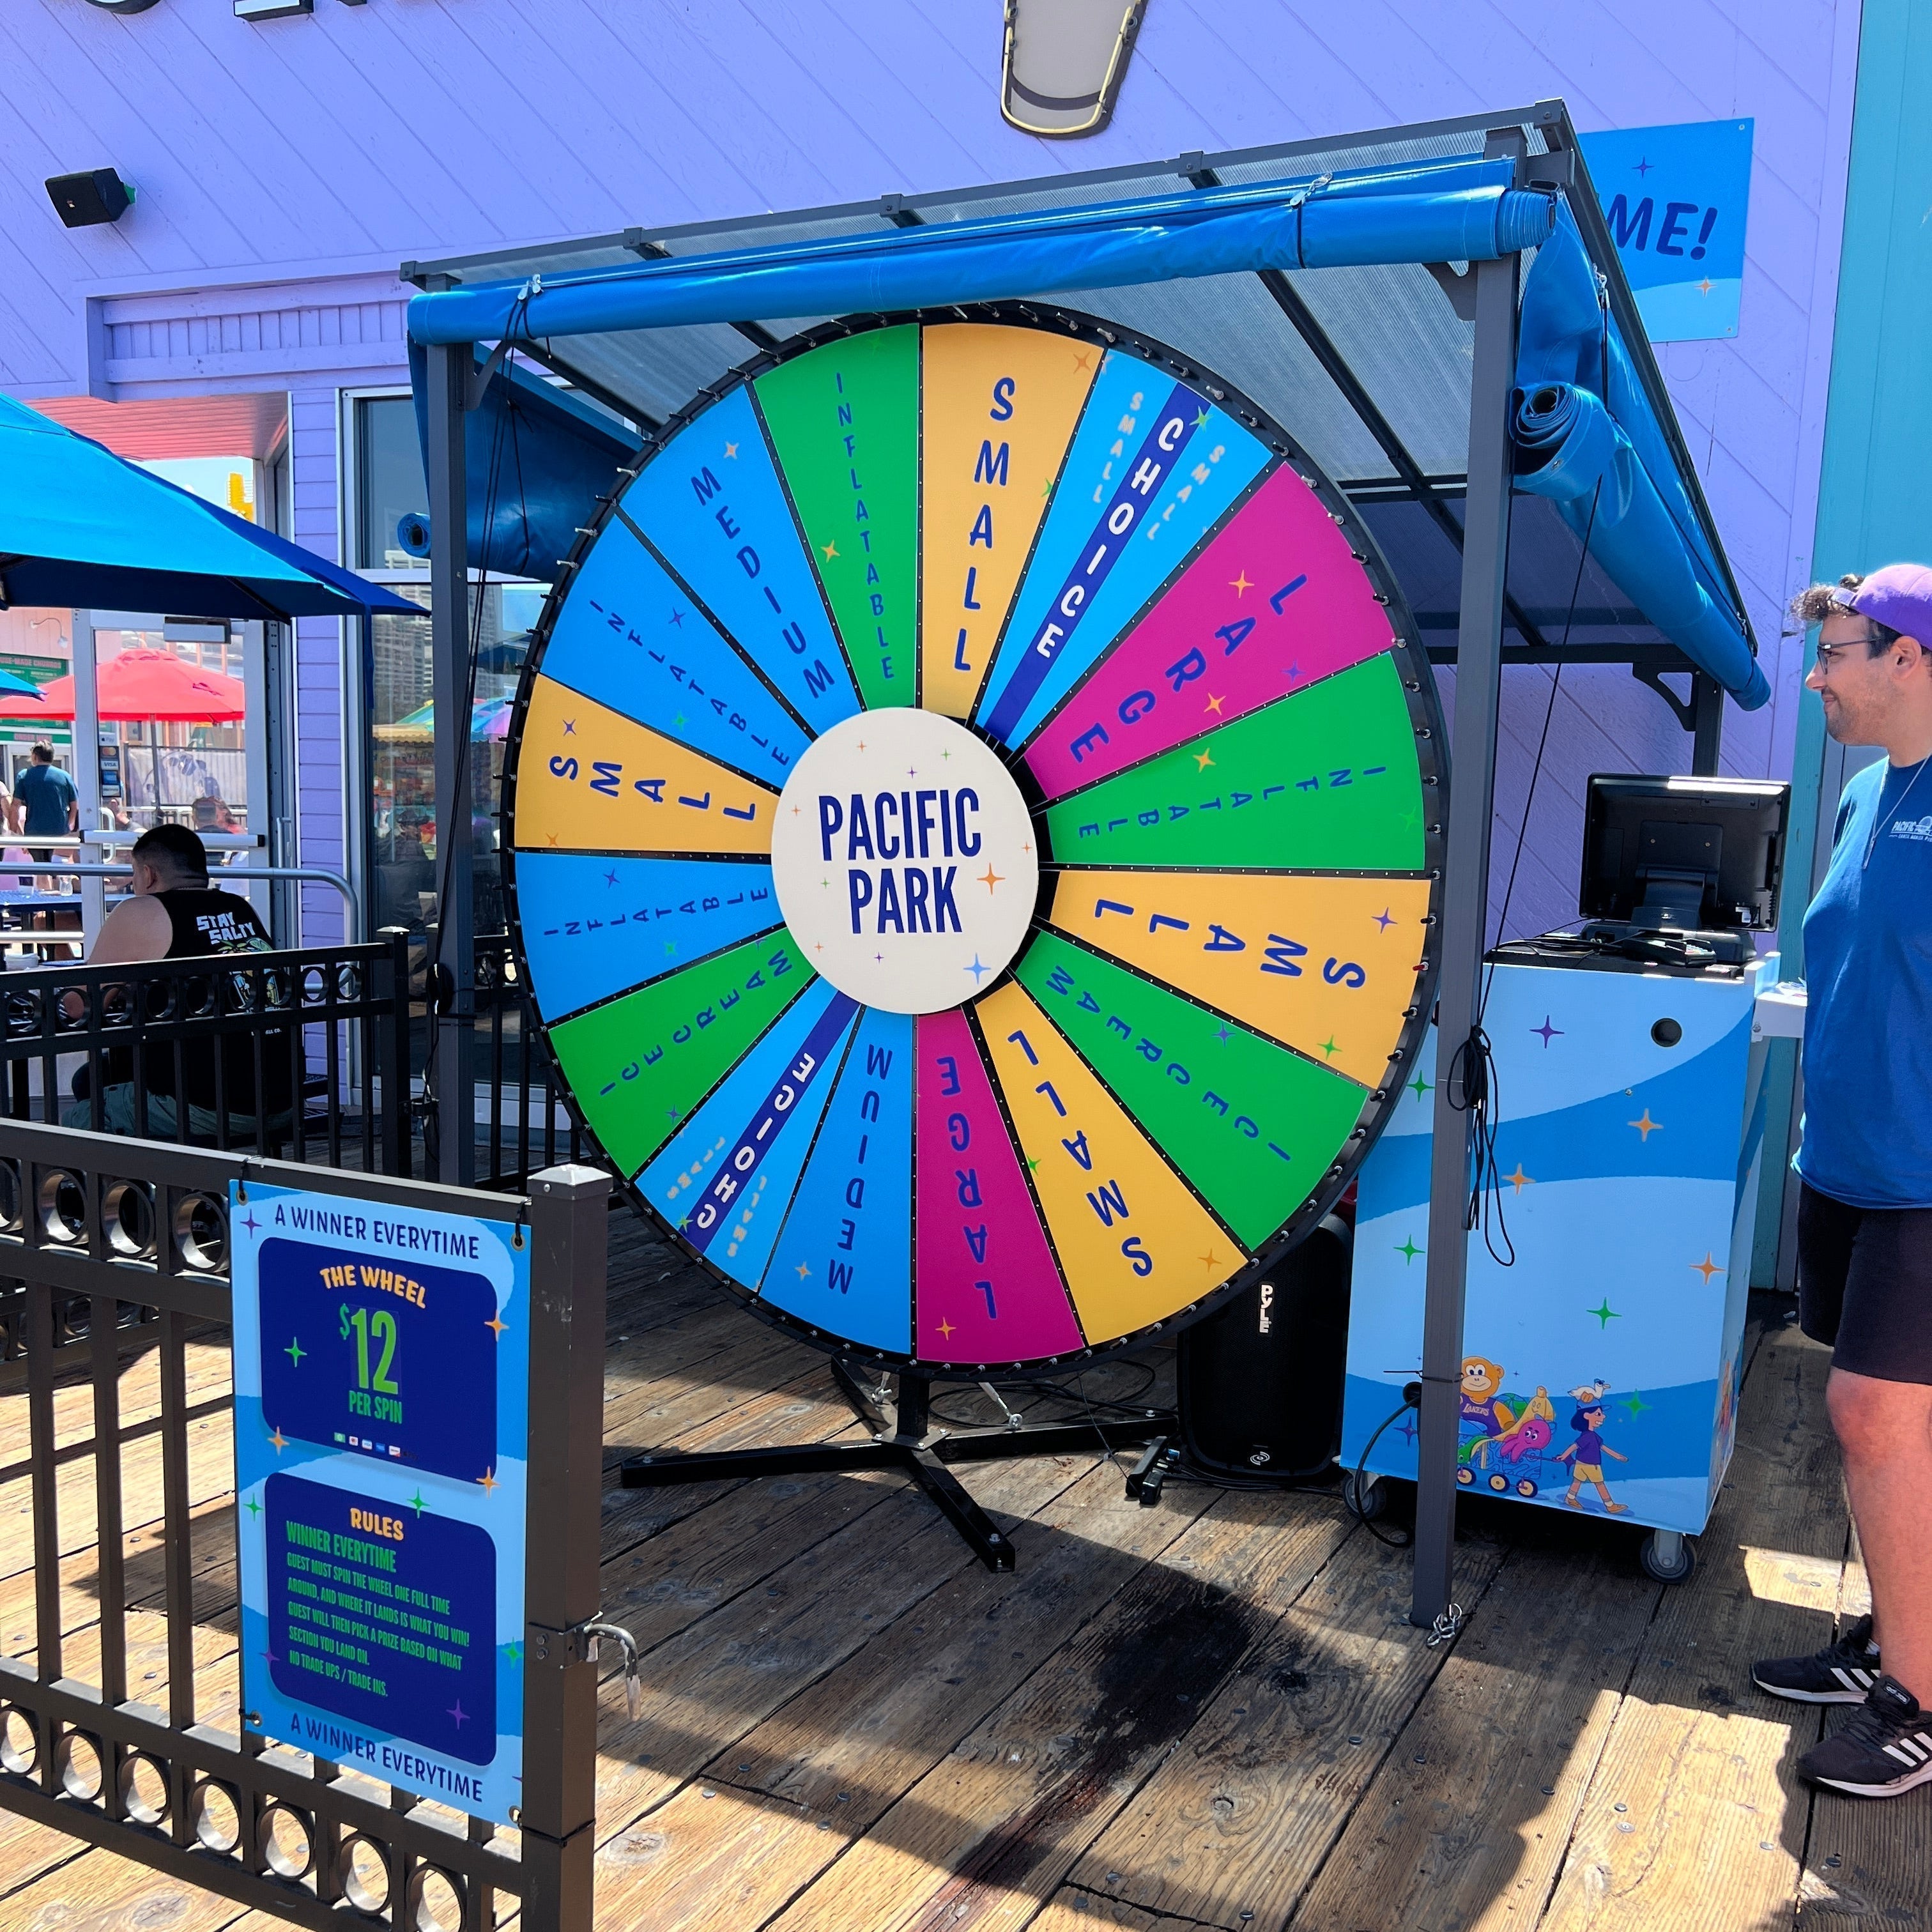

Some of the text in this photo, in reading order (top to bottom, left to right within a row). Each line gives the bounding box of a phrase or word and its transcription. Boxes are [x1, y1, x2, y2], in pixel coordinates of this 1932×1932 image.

[836, 372, 895, 679] INFLATABLE
[954, 376, 1016, 671] SMALL
[1036, 417, 1184, 658] CHOICE
[691, 466, 836, 699] MEDIUM
[589, 600, 790, 765] INFLATABLE
[1070, 573, 1307, 763] LARGE
[549, 755, 756, 822] SMALL
[818, 787, 983, 862] PACIFIC
[1078, 765, 1387, 838] INFLATABLE
[196, 912, 235, 931] STAY
[208, 922, 256, 945] SALTY
[544, 887, 769, 937] INFLATABLE
[848, 866, 963, 935] PARK
[1094, 898, 1367, 988] SMALL
[599, 949, 794, 1096] ICE CREAM
[1044, 964, 1292, 1162] ICE CREAM
[697, 1052, 816, 1229] CHOICE
[828, 1043, 893, 1295] MEDIUM
[1007, 1029, 1153, 1277] SMALL
[935, 1056, 997, 1319] LARGE
[275, 1204, 480, 1259] A WINNER EVERYTIME
[319, 1264, 427, 1309] THE WHEEL
[1259, 1284, 1273, 1334] PYLE
[339, 1303, 399, 1395] $12
[349, 1390, 402, 1425] PER SPIN
[1462, 1403, 1490, 1416] LAKERS
[286, 1520, 397, 1573] WINNER EVERYTIME
[350, 1507, 404, 1541] RULES
[288, 1552, 450, 1615] GUEST MUST SPIN THE WHEEL ONE FULL TIME
[288, 1577, 470, 1648] AROUND, AND WHERE IT LANDS IS WHAT YOU WIN!
[289, 1601, 463, 1671] GUEST WILL THEN PICK A PRIZE BASED ON WHAT
[289, 1625, 370, 1666] SECTION YOU LAND ON.
[289, 1650, 300, 1666] NO
[301, 1653, 324, 1674] TRADE
[326, 1662, 340, 1680] UPS
[348, 1669, 371, 1691] TRADE
[373, 1678, 388, 1698] INS.
[291, 1712, 483, 1803] A WINNER EVERYTIME
